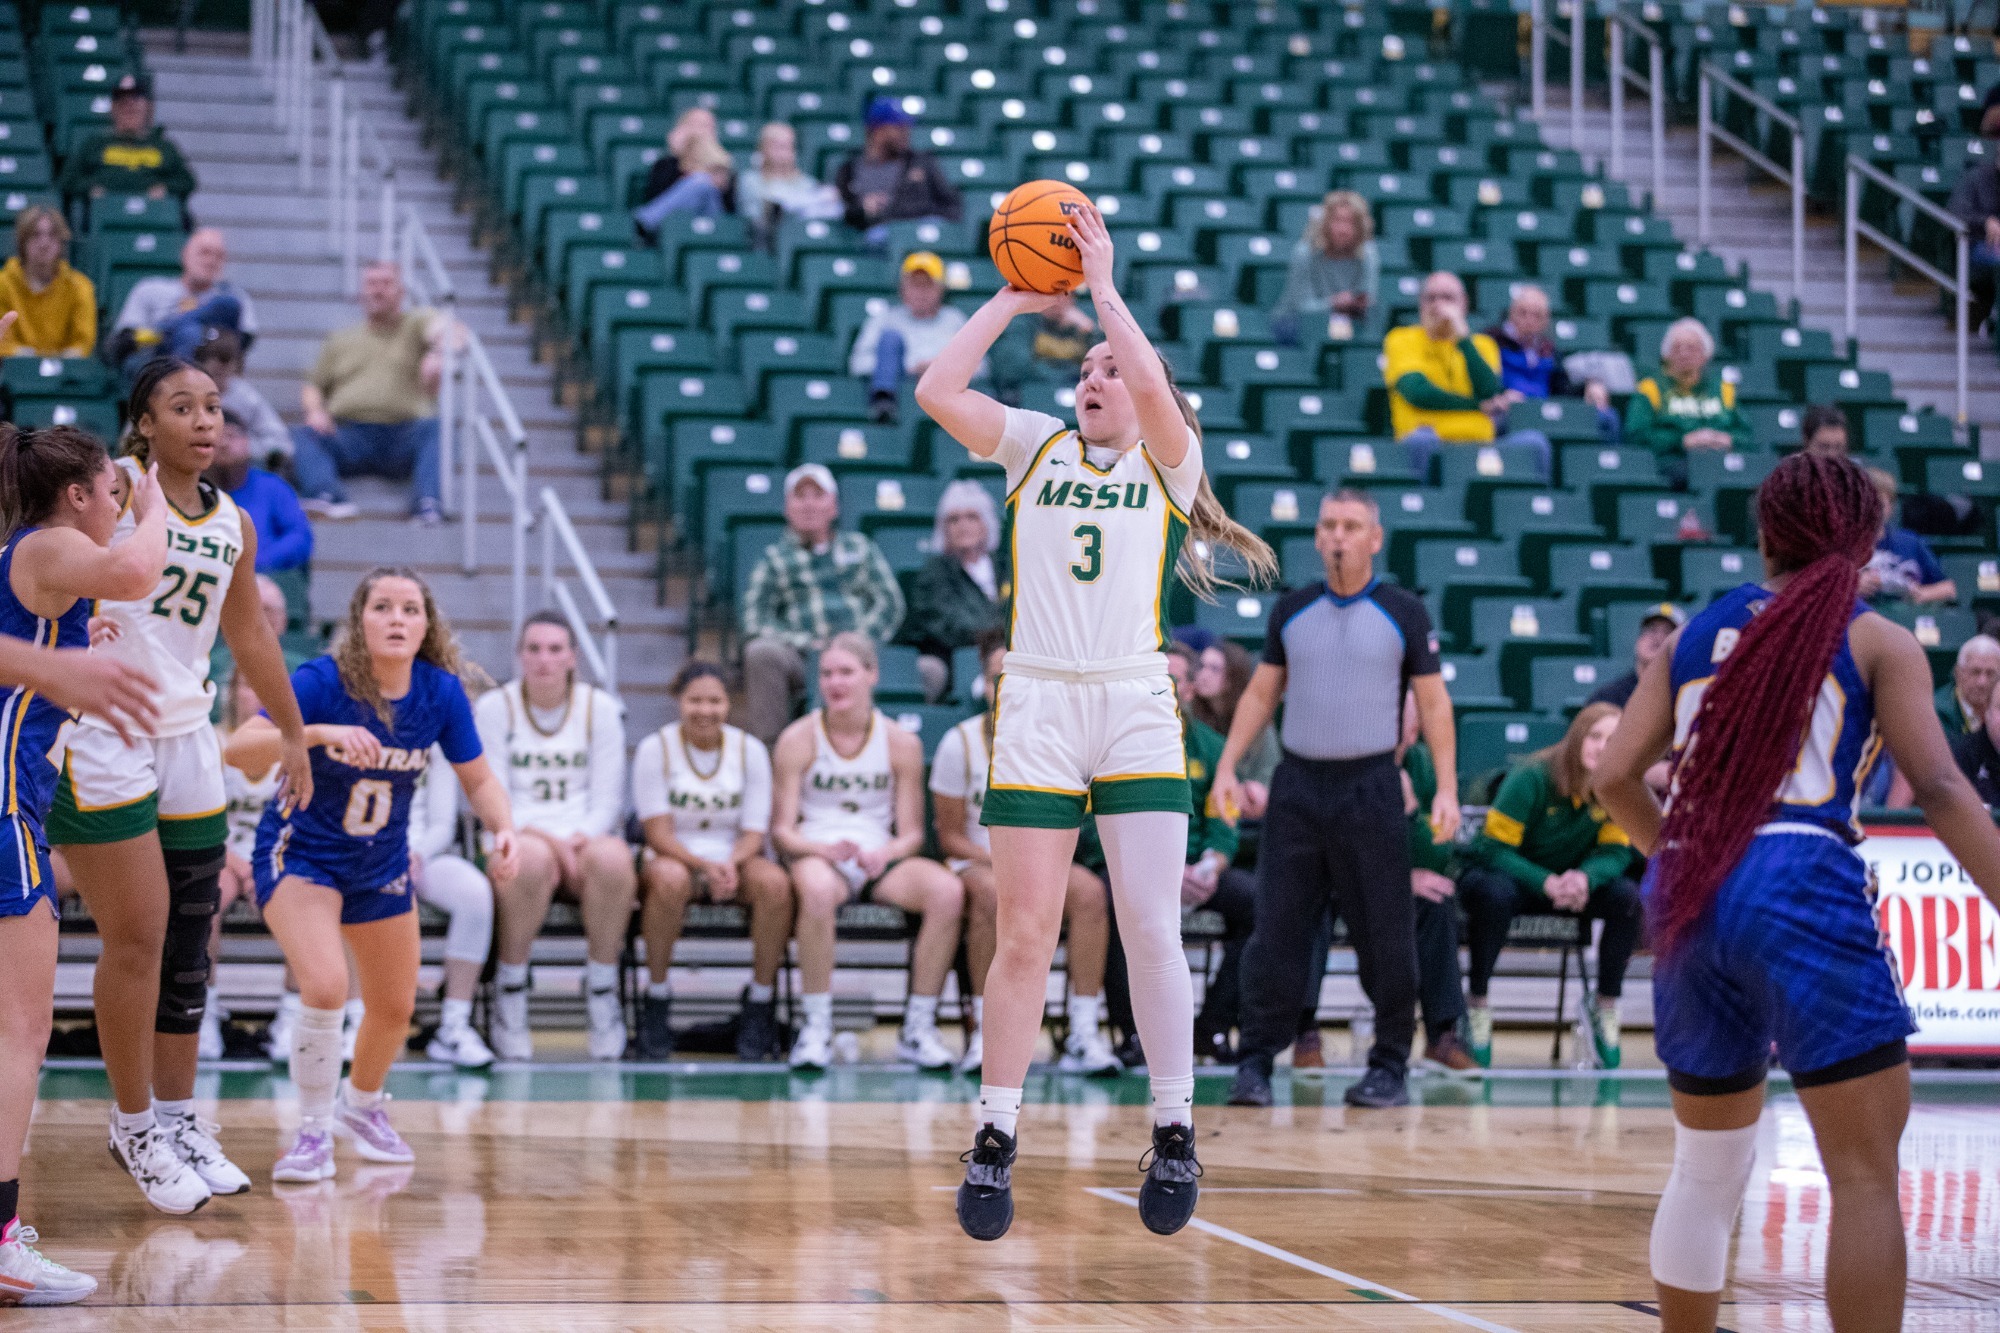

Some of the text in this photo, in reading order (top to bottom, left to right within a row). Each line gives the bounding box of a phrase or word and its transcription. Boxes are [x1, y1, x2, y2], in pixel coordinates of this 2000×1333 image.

[1036, 479, 1147, 510] MSSU
[166, 529, 238, 567] SSU
[1069, 522, 1104, 584] 3
[150, 564, 219, 627] 25
[325, 744, 432, 771] CTRA
[342, 778, 392, 836] 0
[1898, 861, 1969, 883] JOPL
[1880, 893, 1999, 990] OBE
